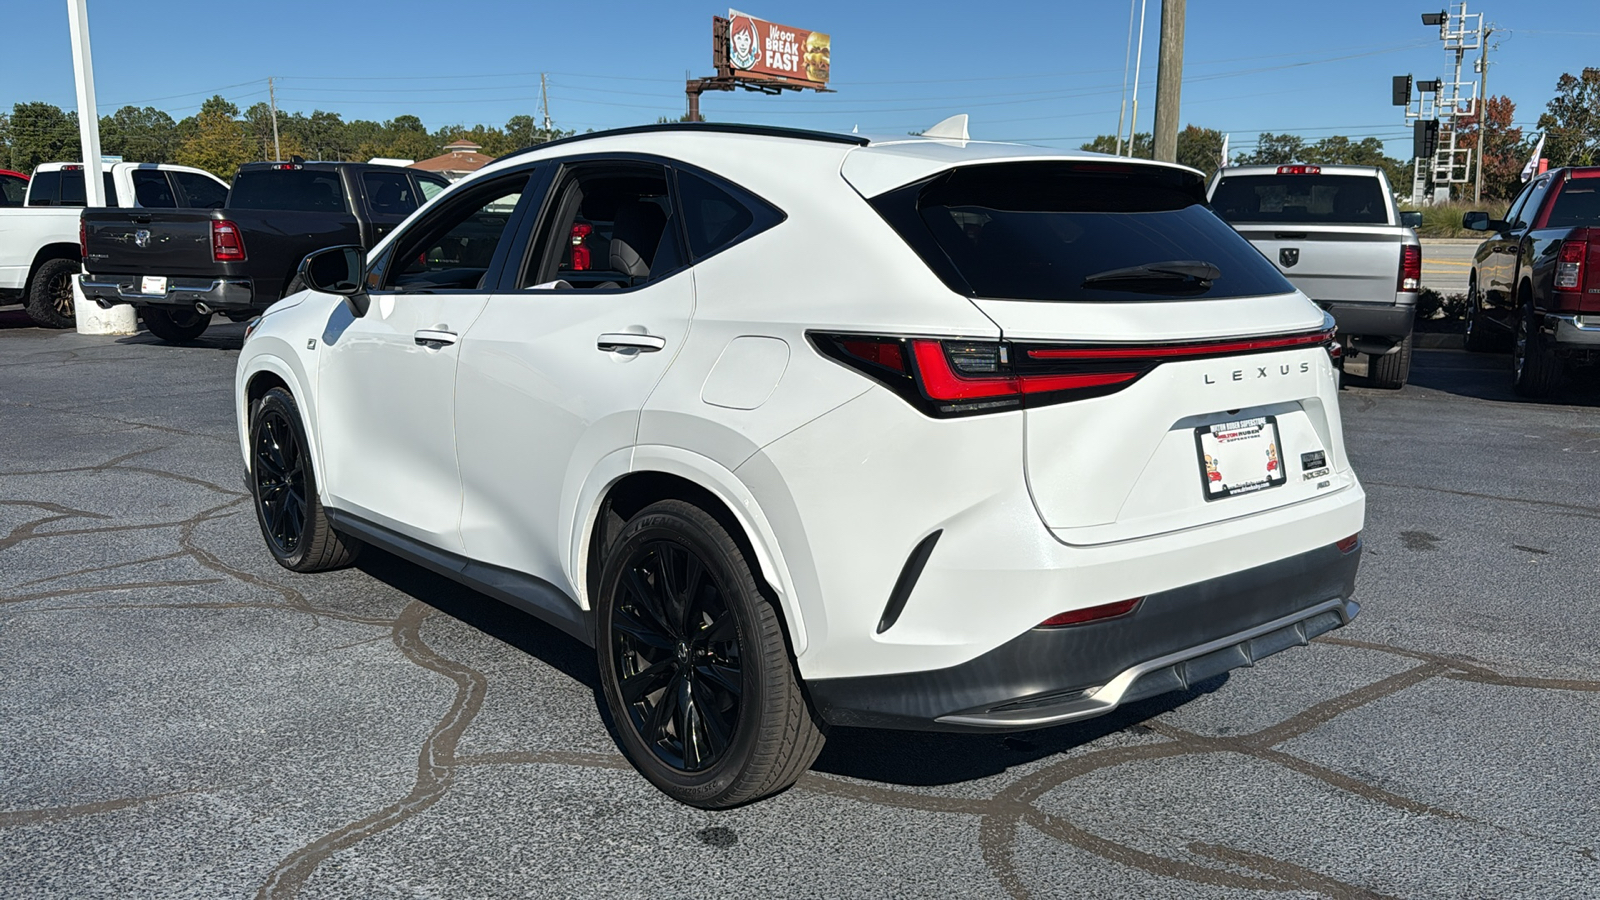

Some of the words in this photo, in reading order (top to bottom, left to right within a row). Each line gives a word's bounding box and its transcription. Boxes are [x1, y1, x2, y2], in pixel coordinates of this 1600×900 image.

[780, 31, 795, 42] GOT
[765, 37, 799, 56] BREAK
[765, 50, 799, 72] FAST
[1204, 362, 1309, 384] LEXUS
[1238, 429, 1260, 437] RUBEN
[1302, 467, 1330, 481] NX350
